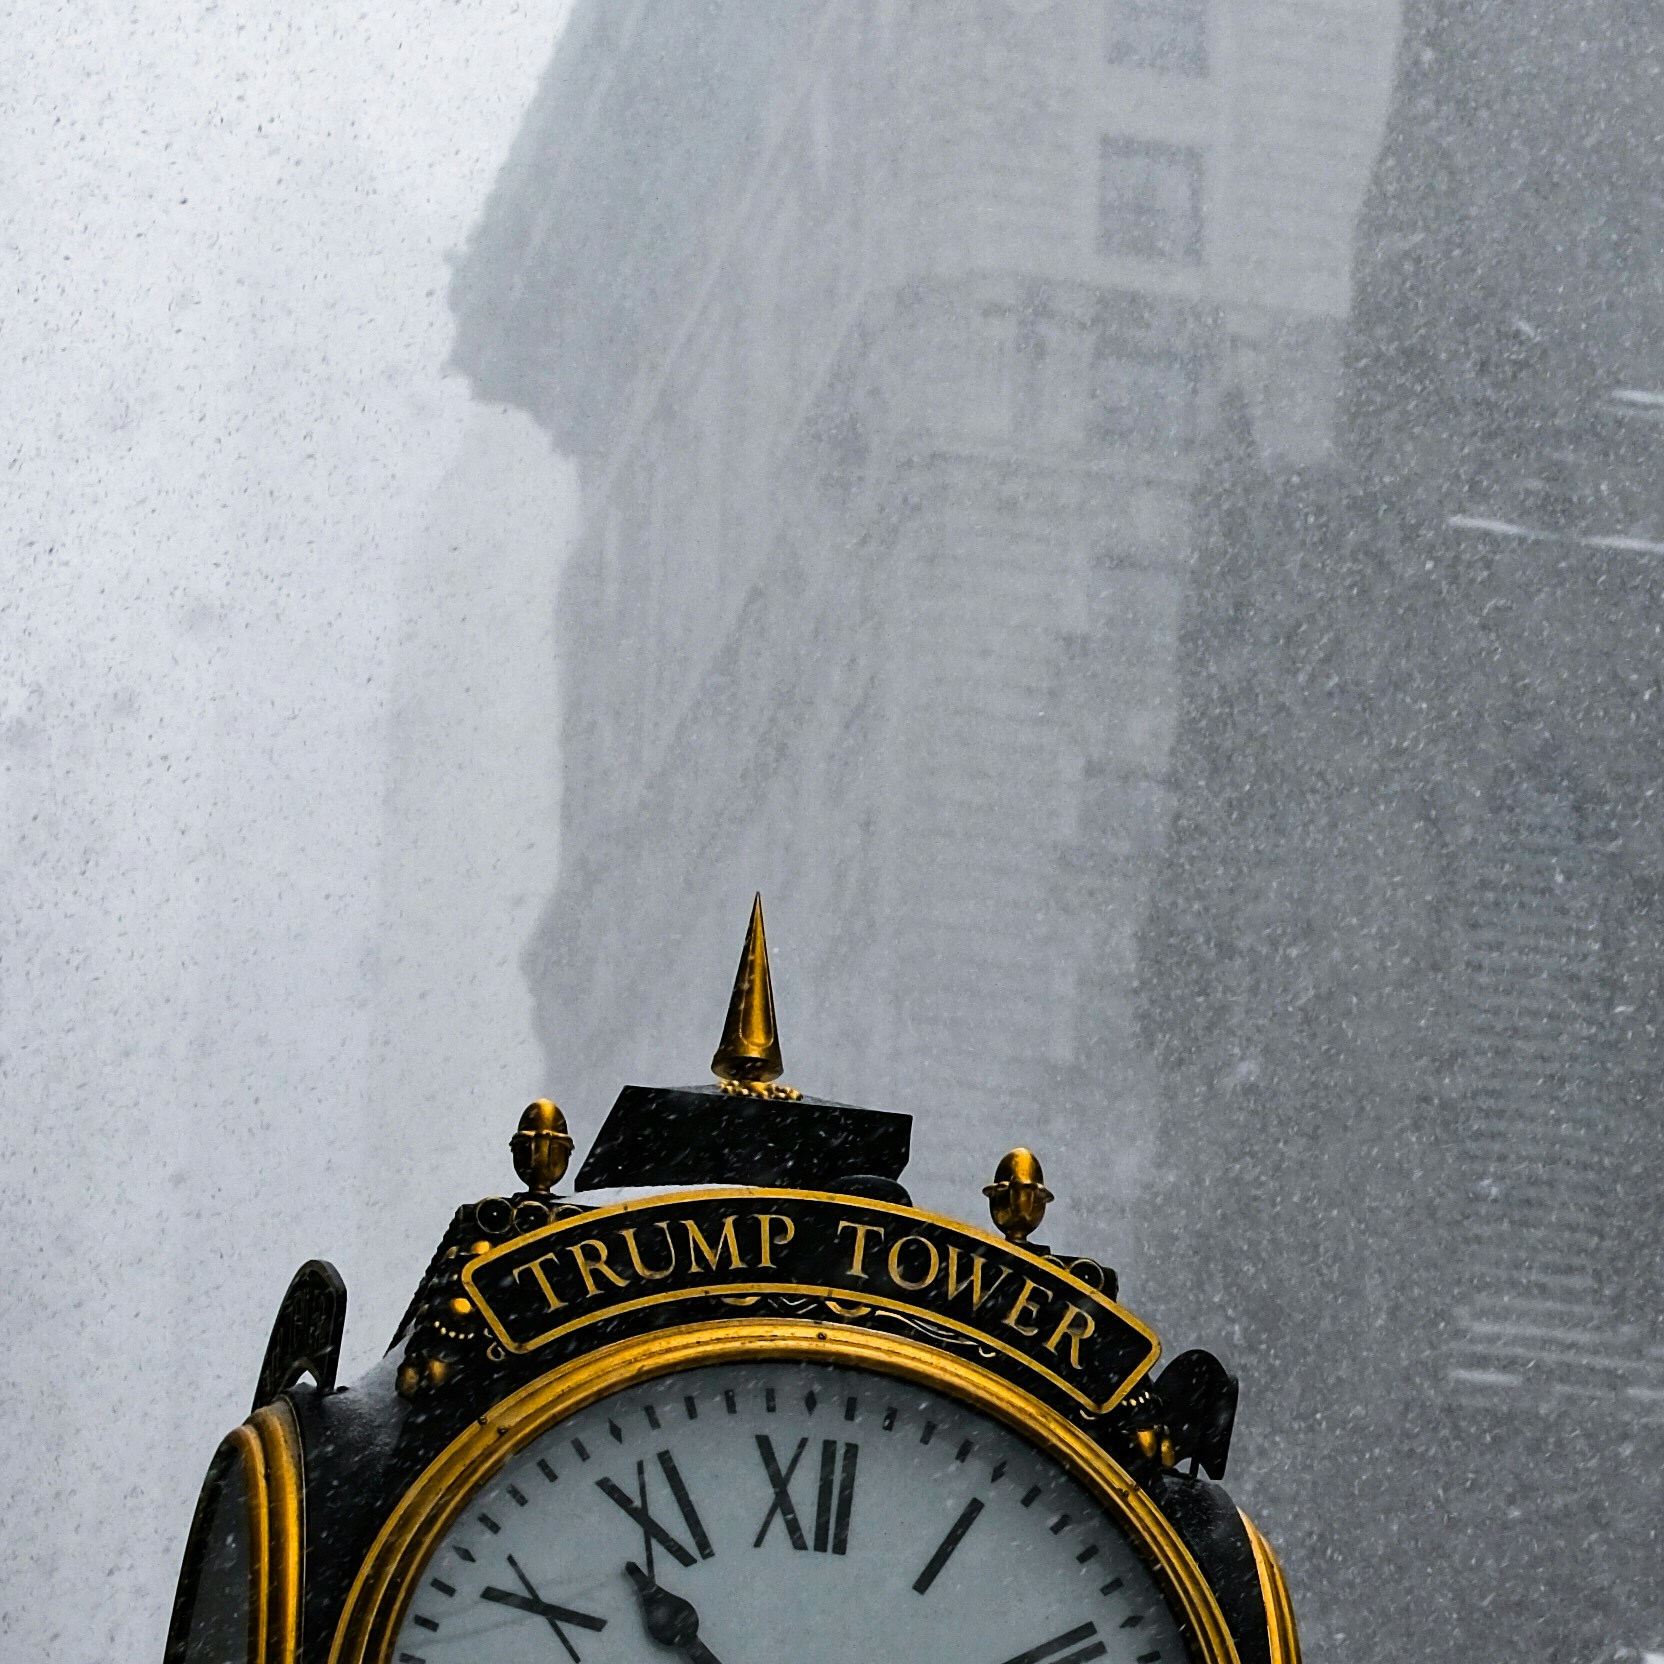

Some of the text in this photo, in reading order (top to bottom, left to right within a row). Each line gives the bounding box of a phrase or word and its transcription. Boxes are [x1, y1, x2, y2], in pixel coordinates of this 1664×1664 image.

[512, 1213, 1098, 1371] TRUMP TOWER
[595, 1449, 715, 1579] XI
[753, 1433, 860, 1556] XII
[911, 1497, 985, 1596] I
[480, 1554, 608, 1664] X
